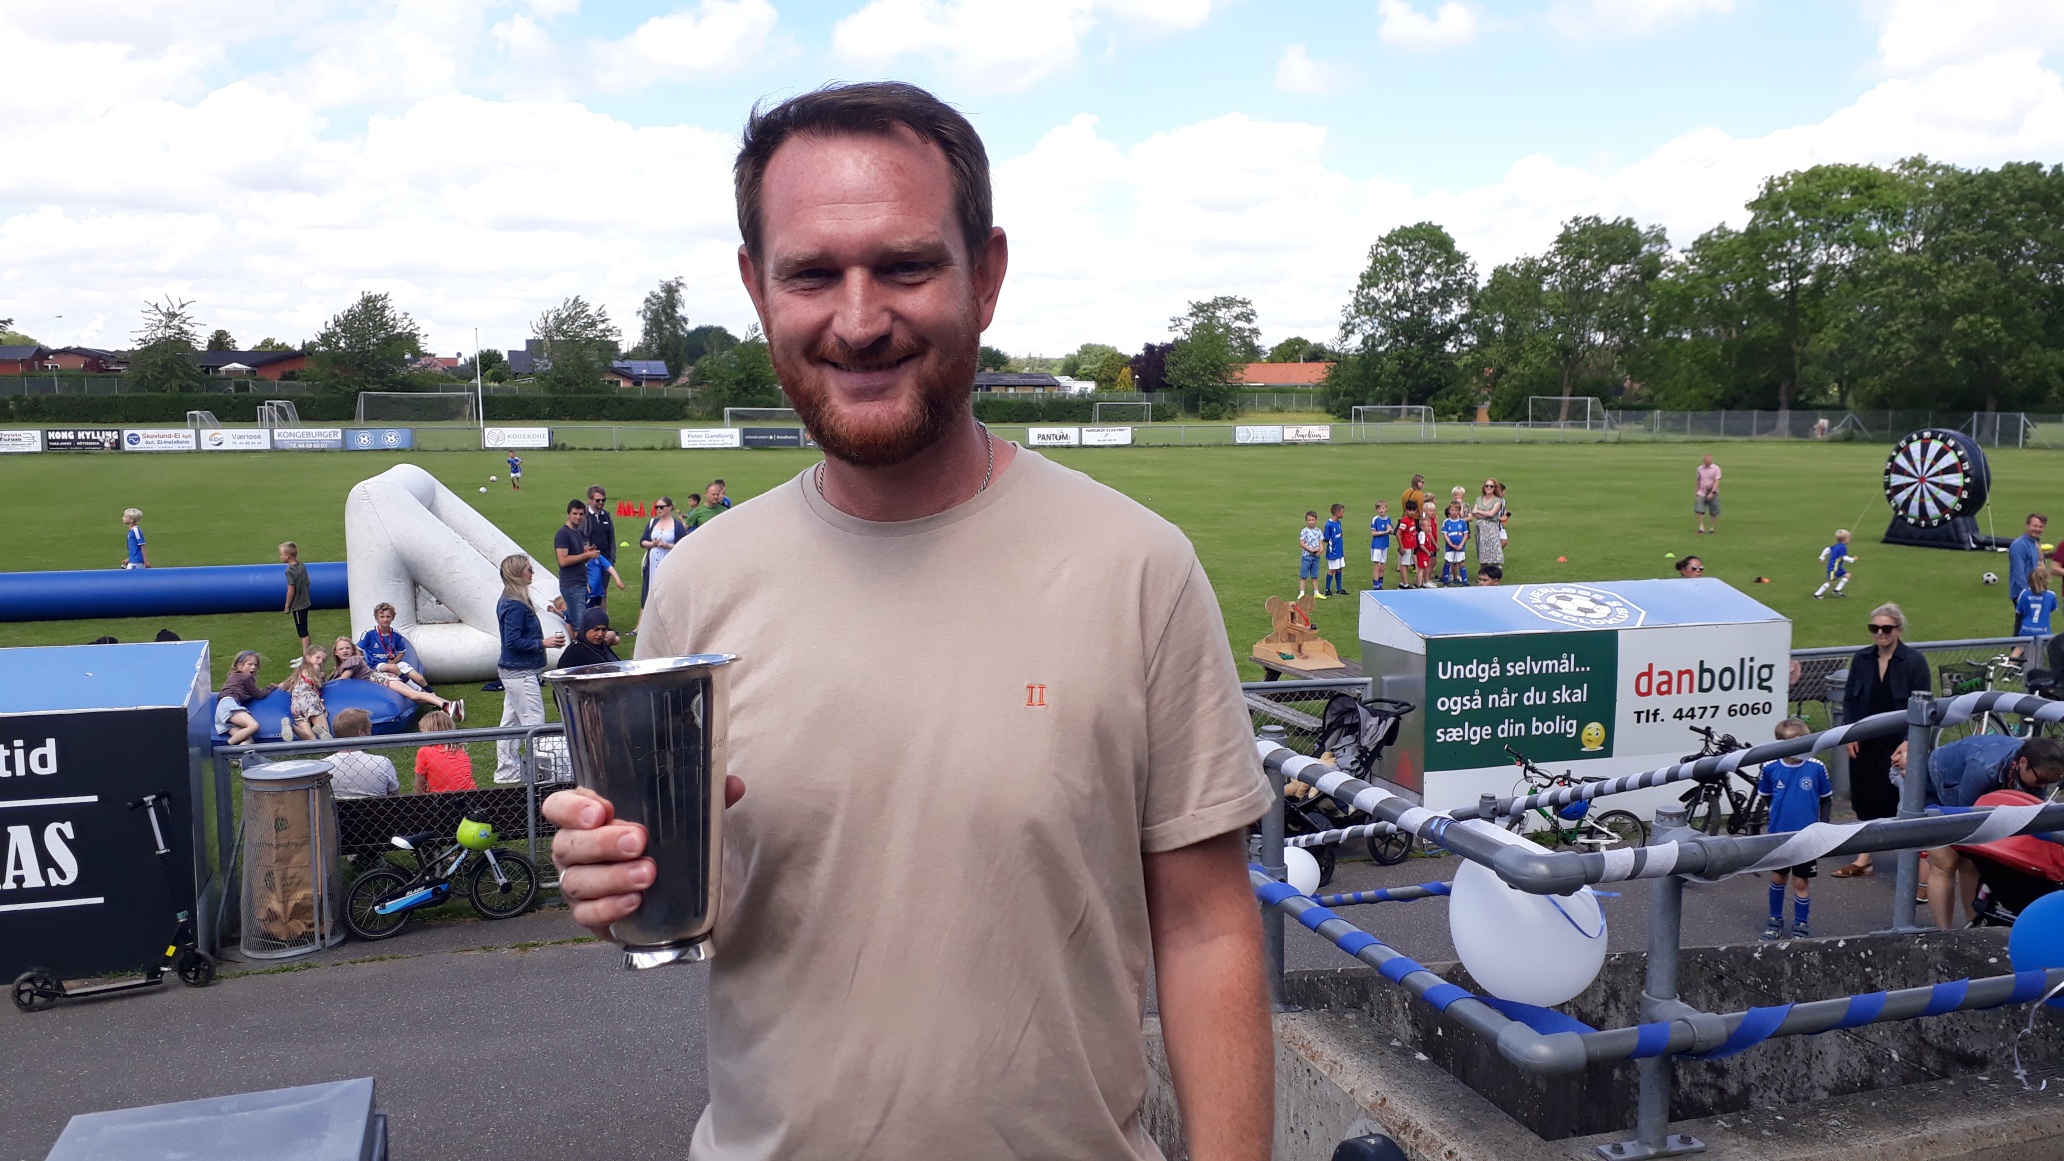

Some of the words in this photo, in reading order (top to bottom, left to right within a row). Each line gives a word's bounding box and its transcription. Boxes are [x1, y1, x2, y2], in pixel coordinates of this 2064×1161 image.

[48, 431, 74, 440] KONG
[78, 431, 118, 440] KYLLING
[2030, 604, 2042, 623] 7
[1438, 657, 1500, 682] Undgå
[1506, 653, 1590, 676] selvmål...
[1634, 656, 1775, 697] danbolig
[1437, 689, 1482, 715] også
[1488, 687, 1518, 708] når
[1523, 686, 1546, 706] du
[1552, 683, 1588, 704] skal
[1634, 709, 1664, 724] Tlf.
[1672, 705, 1720, 720] 4477
[1728, 702, 1772, 717] 6060
[1436, 721, 1492, 745] sælge
[1497, 718, 1525, 738] din
[1531, 715, 1577, 738] bolig
[0, 821, 78, 890] AS
